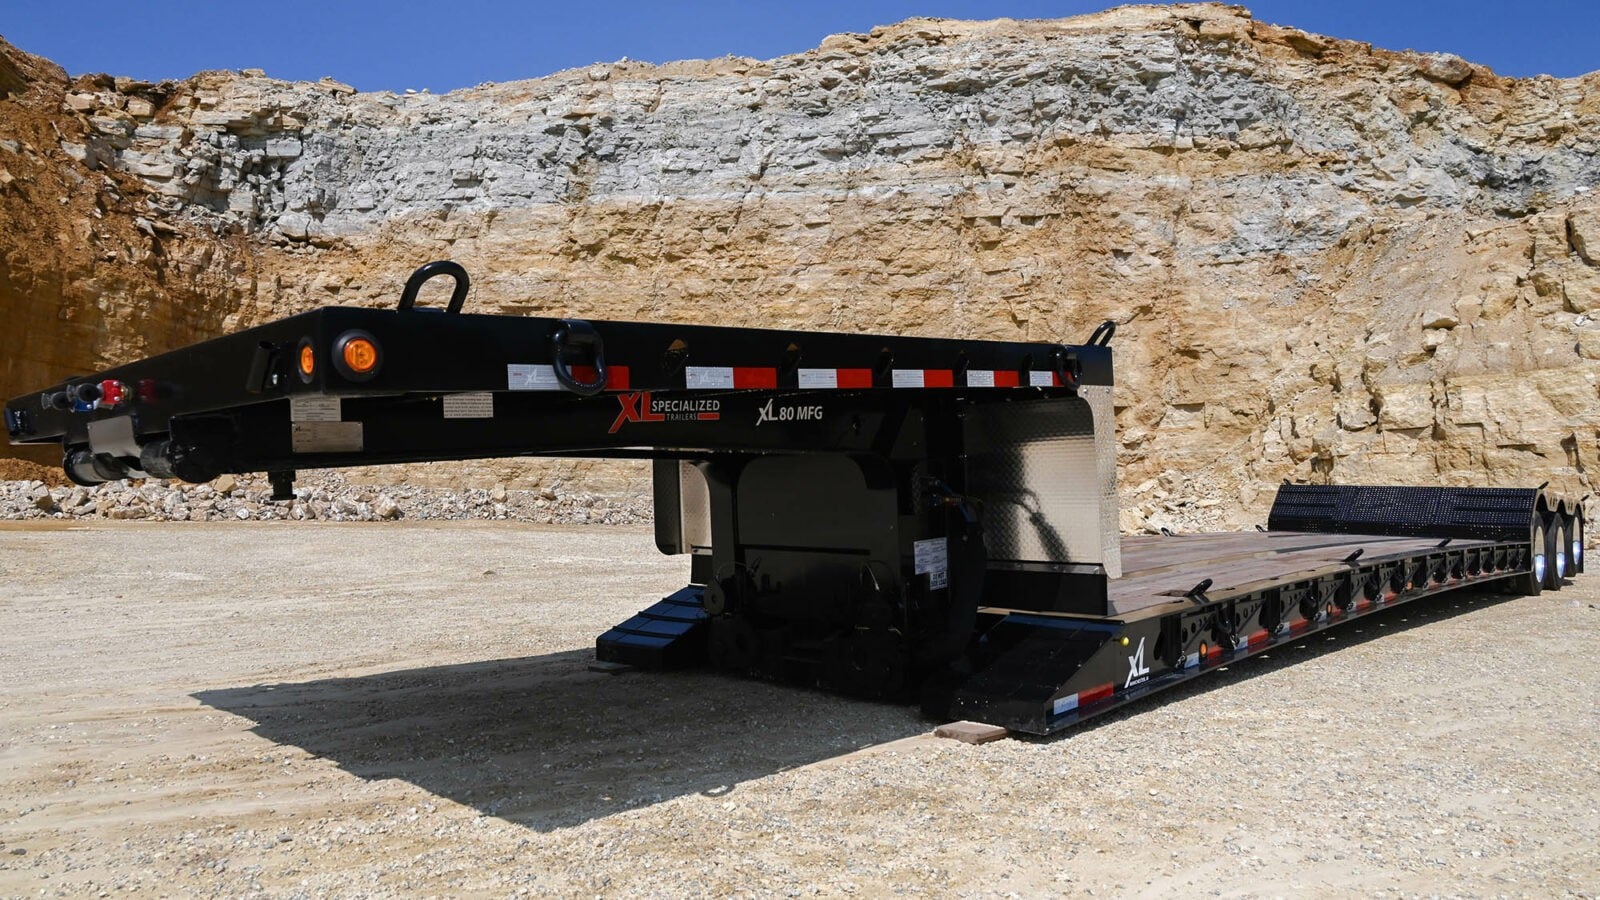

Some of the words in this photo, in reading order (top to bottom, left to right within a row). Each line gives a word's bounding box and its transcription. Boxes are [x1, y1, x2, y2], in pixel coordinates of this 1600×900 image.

[608, 391, 665, 433] XL
[652, 400, 720, 411] SPECIALIZED
[756, 398, 778, 426] XL
[779, 406, 794, 420] 80
[796, 406, 823, 420] MFG
[1124, 636, 1150, 688] XL
